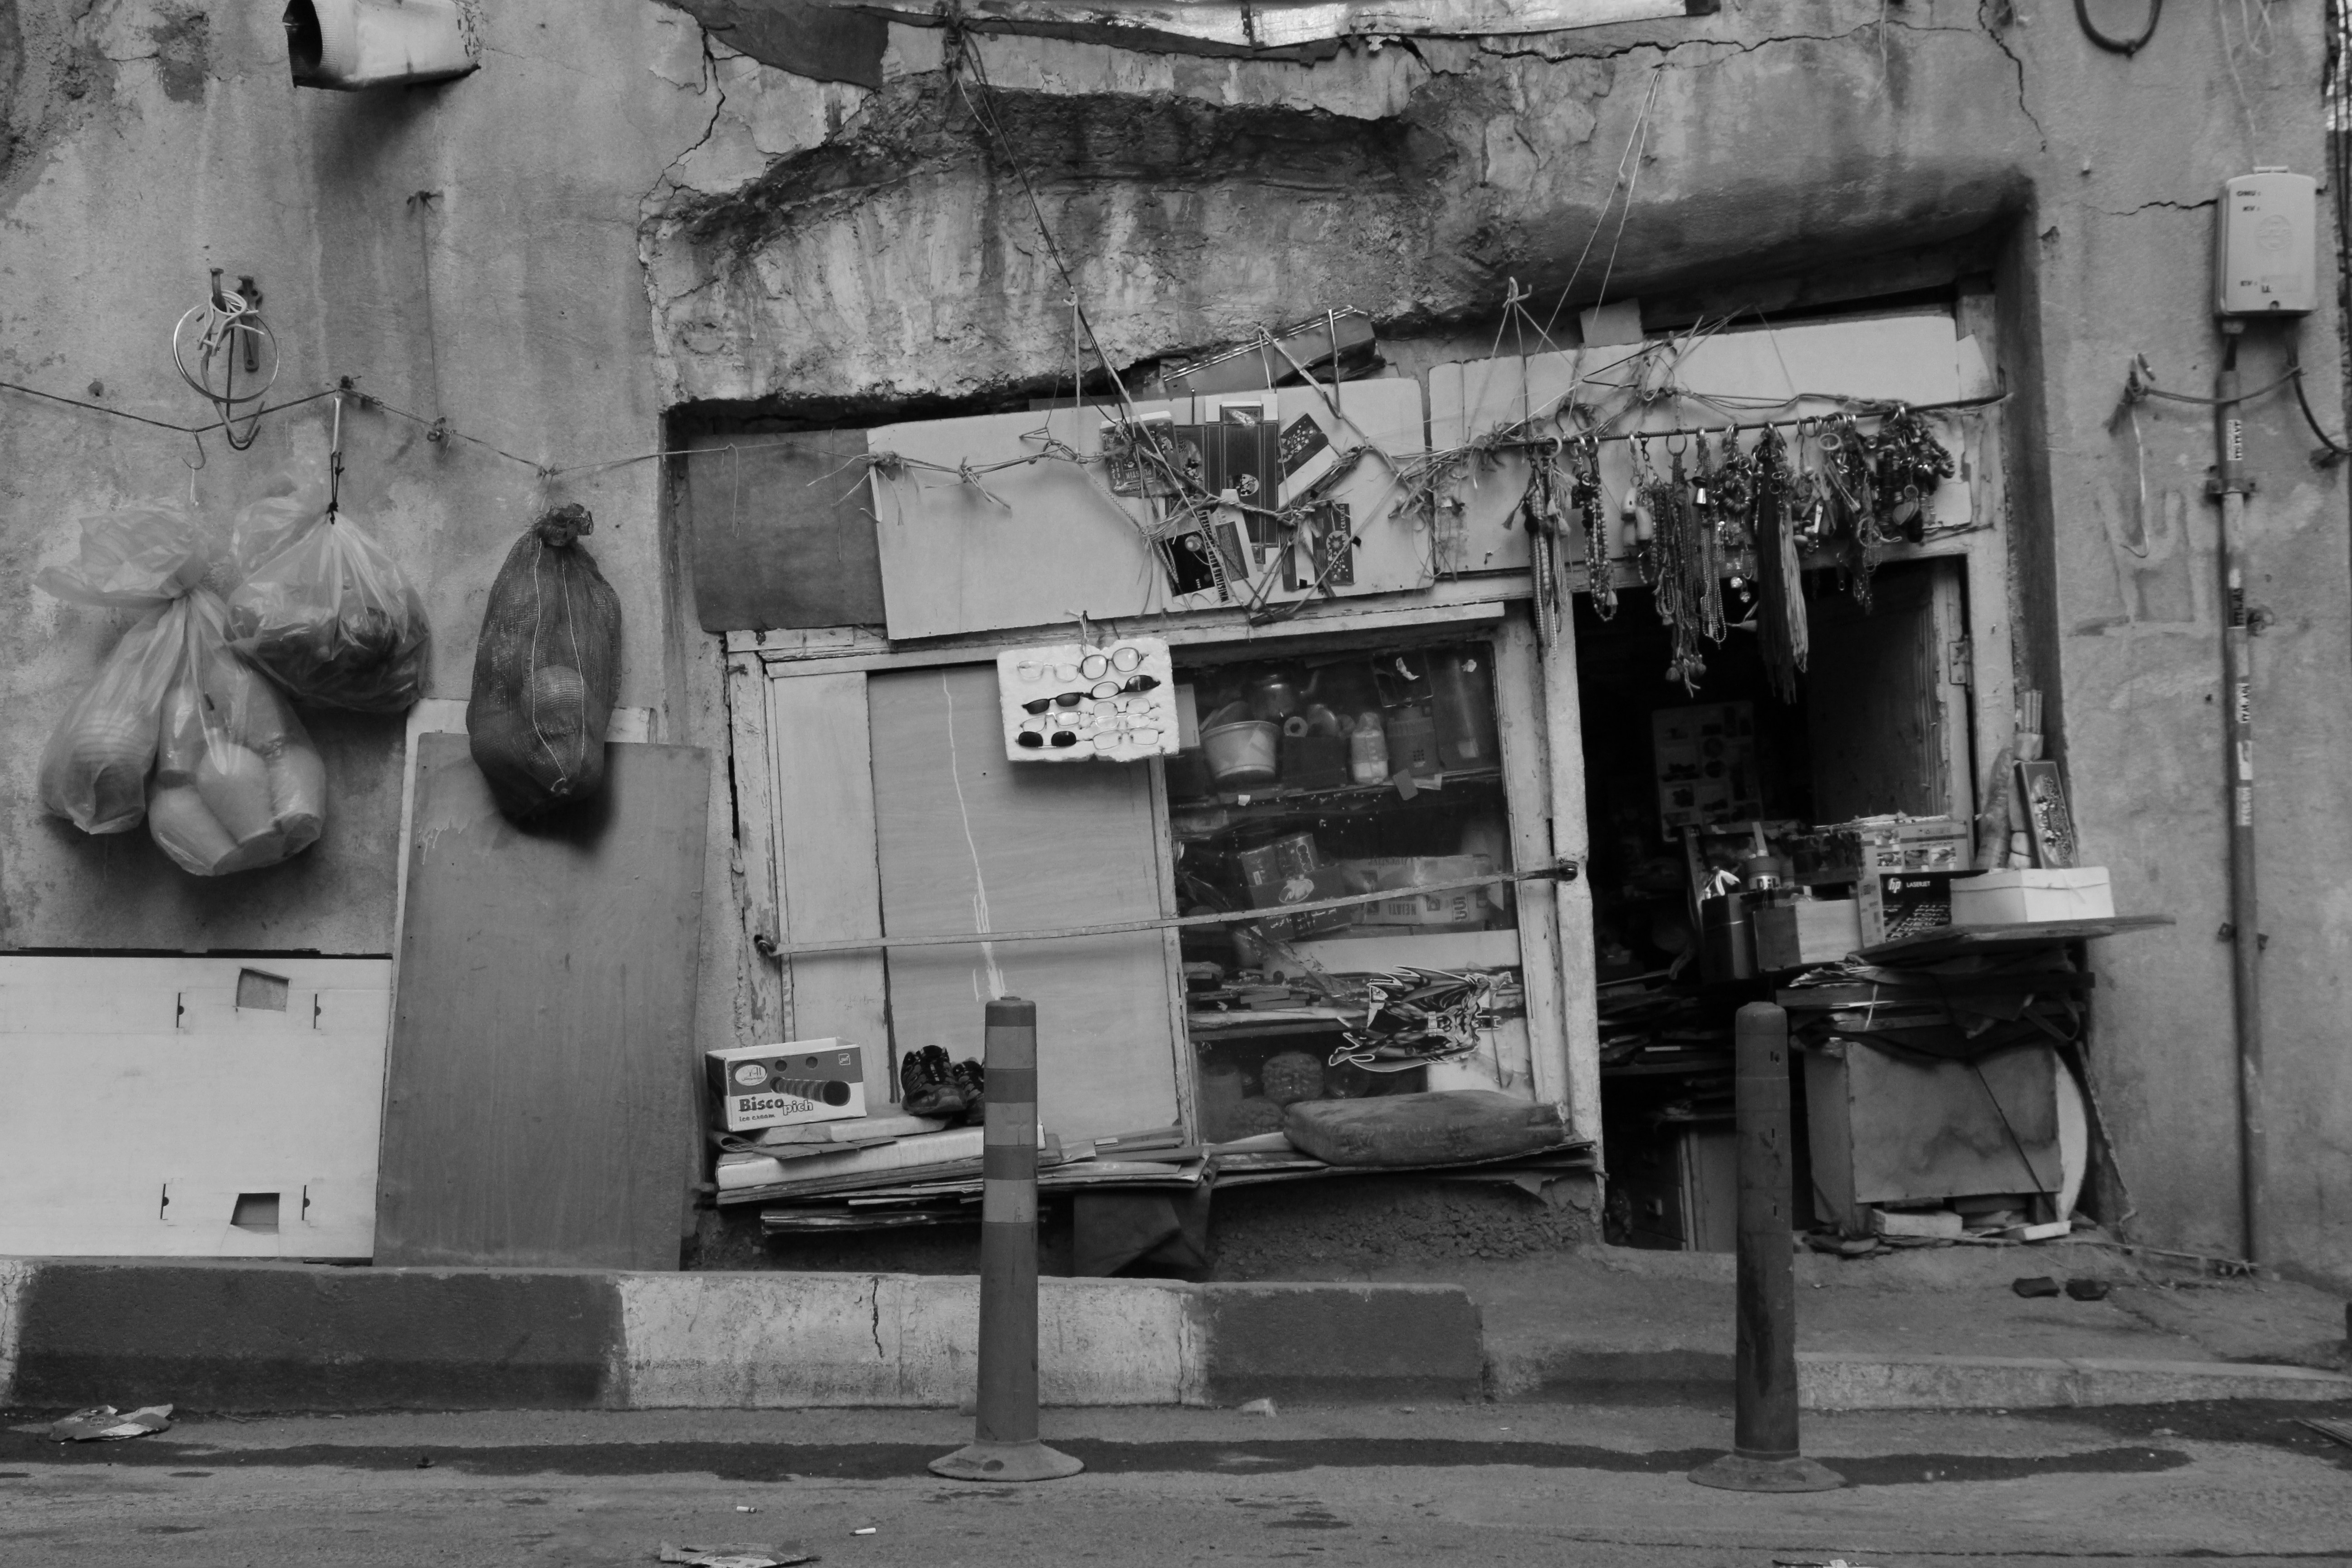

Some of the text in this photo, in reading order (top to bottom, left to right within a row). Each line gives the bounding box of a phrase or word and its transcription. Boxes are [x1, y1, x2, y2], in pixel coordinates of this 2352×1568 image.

[1207, 550, 1221, 568] MOON
[1213, 568, 1230, 603] WHISTLING
[1888, 877, 1902, 893] hp
[739, 1096, 784, 1112] Bisco
[783, 1099, 813, 1115] pich
